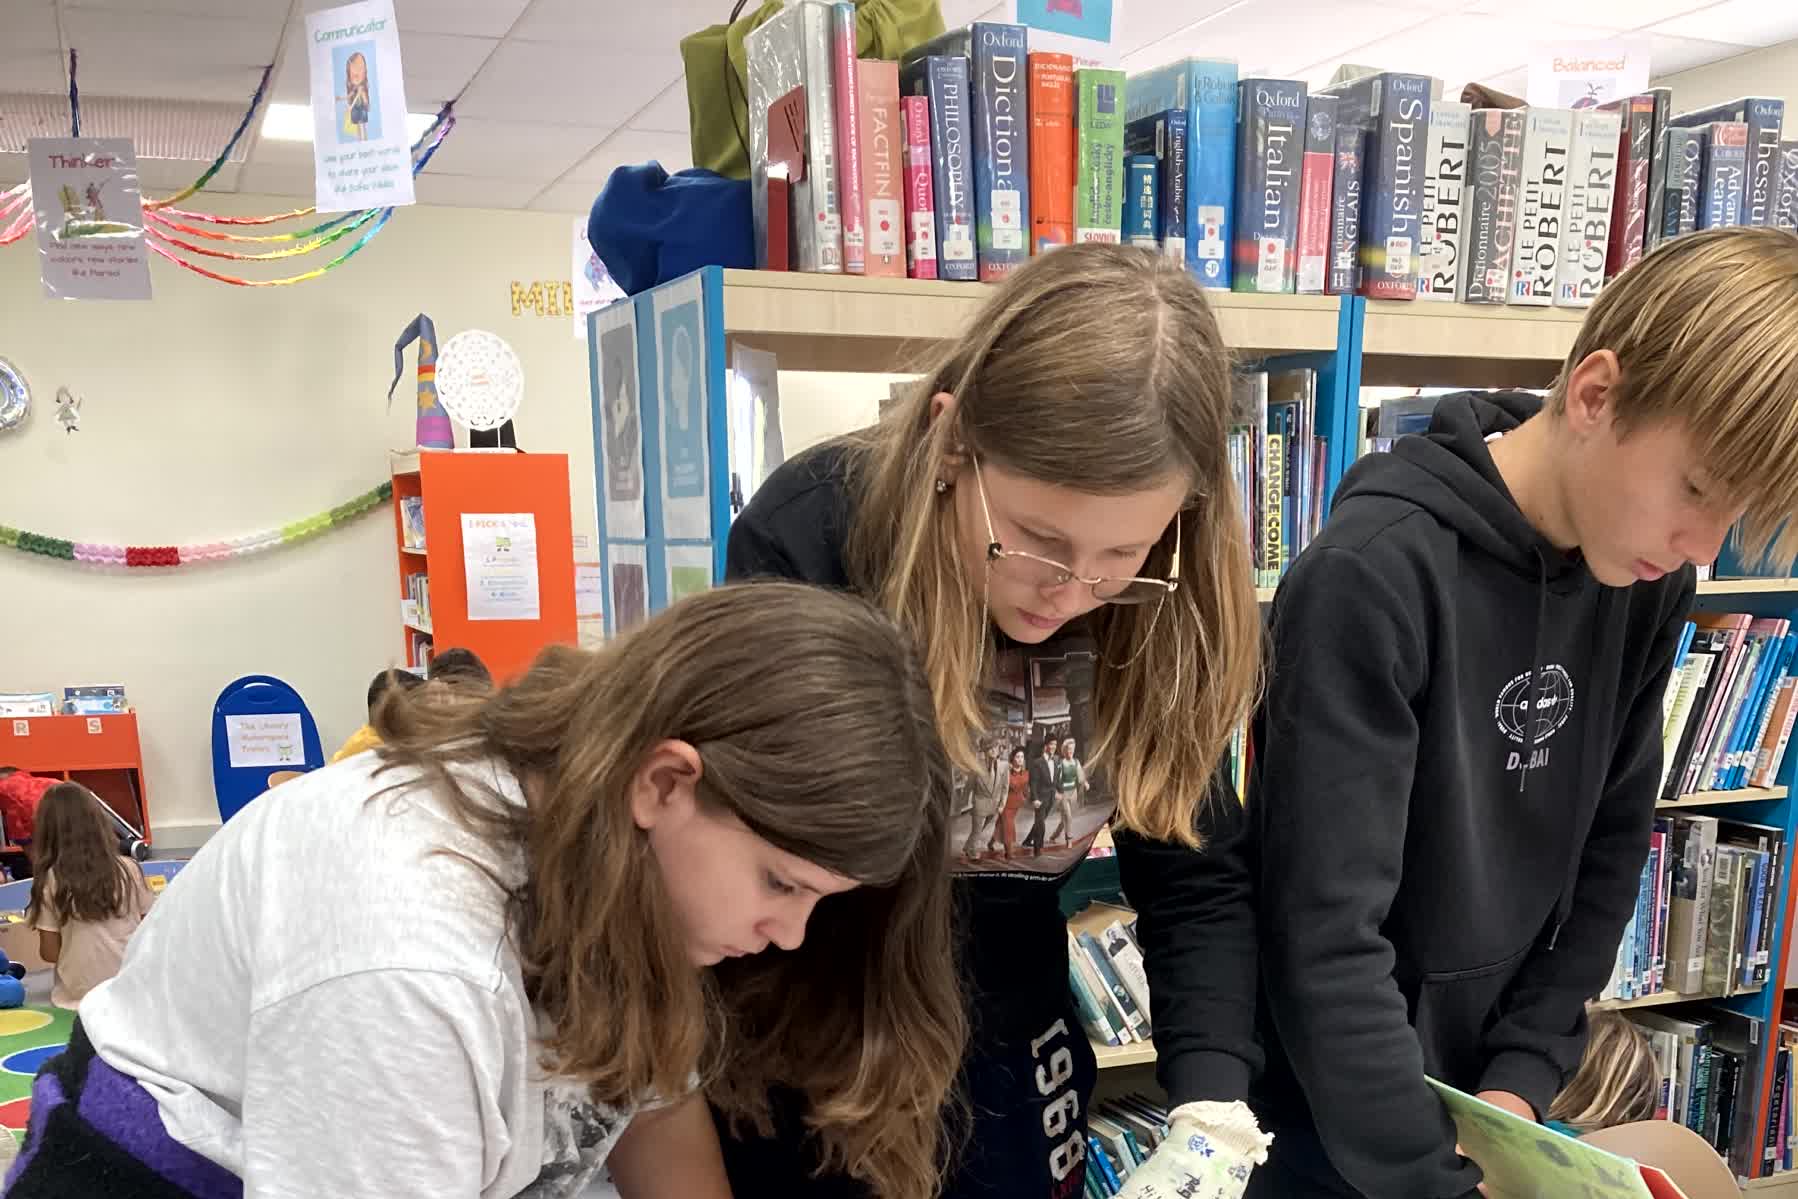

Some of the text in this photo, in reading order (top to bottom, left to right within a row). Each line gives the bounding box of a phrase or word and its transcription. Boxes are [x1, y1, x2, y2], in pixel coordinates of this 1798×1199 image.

[314, 19, 386, 43] Communicator
[983, 31, 1024, 49] Oxford
[1552, 56, 1625, 72] Balanced
[992, 55, 1018, 191] Dictiona
[1257, 90, 1300, 108] Oxford
[1393, 80, 1423, 93] Oxford
[1754, 105, 1782, 117] Oxford
[49, 153, 115, 168] Thinker
[872, 106, 890, 197] FACTFIN
[943, 84, 966, 210] PHILOSOPHY
[1174, 127, 1185, 203] English-Arabic
[1264, 122, 1293, 229] Italian
[1390, 98, 1424, 233] Spanish
[1680, 140, 1700, 222] Oxford
[1751, 119, 1781, 226] Thesau
[1432, 136, 1465, 294] ROBERT
[1469, 141, 1501, 298] Dictionnaire 2005
[1520, 181, 1539, 261] LE PETIT
[1533, 142, 1567, 297] ROBERT
[1567, 185, 1585, 263] LE PETIT
[1579, 146, 1614, 298] ROBERT
[1725, 166, 1742, 227] Advan
[1778, 150, 1797, 229] Oxford
[945, 262, 975, 271] OXFORD
[1266, 437, 1281, 571] CHANGE COME
[15, 721, 27, 734] R
[89, 720, 100, 732] S
[1505, 747, 1550, 770] DBAI
[1031, 1018, 1087, 1181] 1968
[1766, 1074, 1785, 1150] Vegetariani
